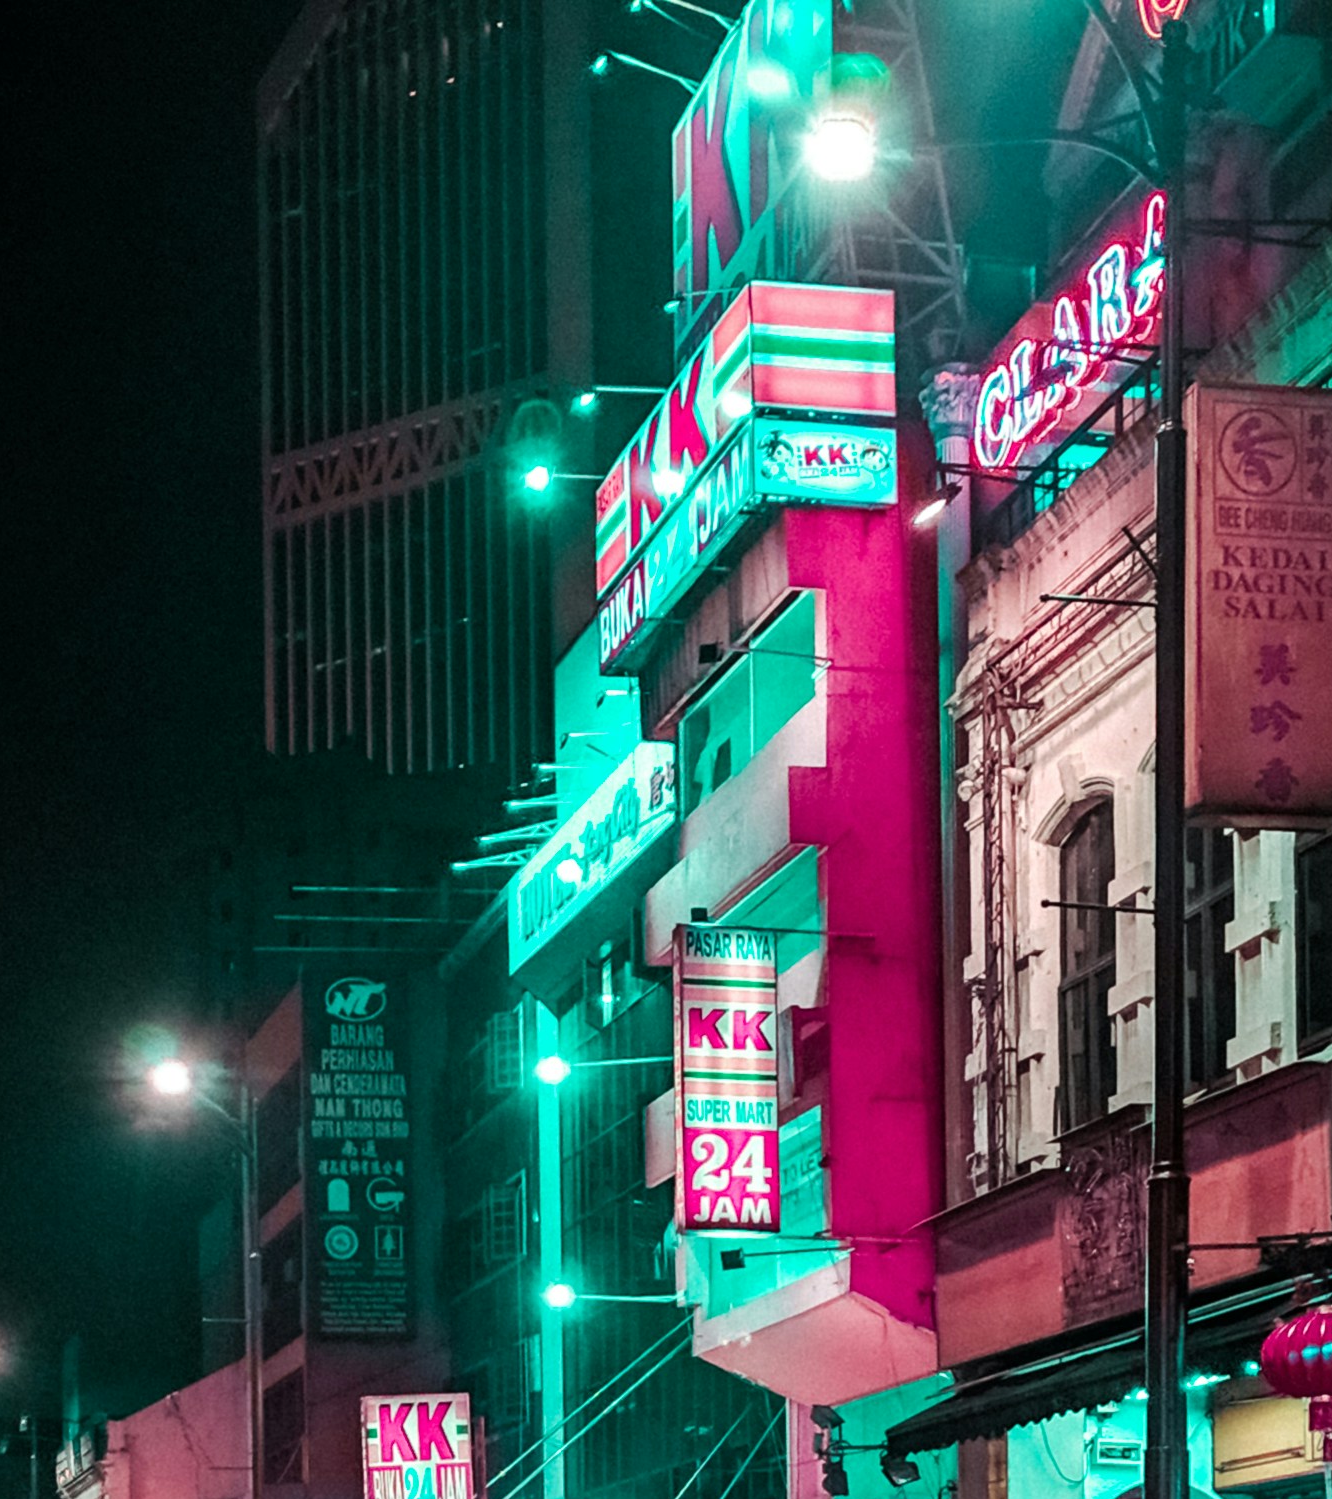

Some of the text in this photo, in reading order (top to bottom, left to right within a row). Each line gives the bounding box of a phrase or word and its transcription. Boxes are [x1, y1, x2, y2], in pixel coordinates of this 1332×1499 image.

[804, 443, 850, 467] KK
[1219, 505, 1242, 528] BEE
[600, 568, 644, 664] BUKA
[699, 440, 750, 544] JAM
[1221, 545, 1331, 572] KEDAI
[1223, 596, 1326, 622] SALAI
[685, 930, 772, 961] PASAR RAYA
[330, 1023, 385, 1047] BARANG
[688, 1007, 773, 1052] KK
[321, 1048, 395, 1072] PERHIASAN
[352, 1098, 404, 1118] THONG
[686, 1099, 774, 1125] SUPER MART
[691, 1133, 773, 1194] 24
[693, 1196, 773, 1225] JAM
[378, 1401, 456, 1462] KK
